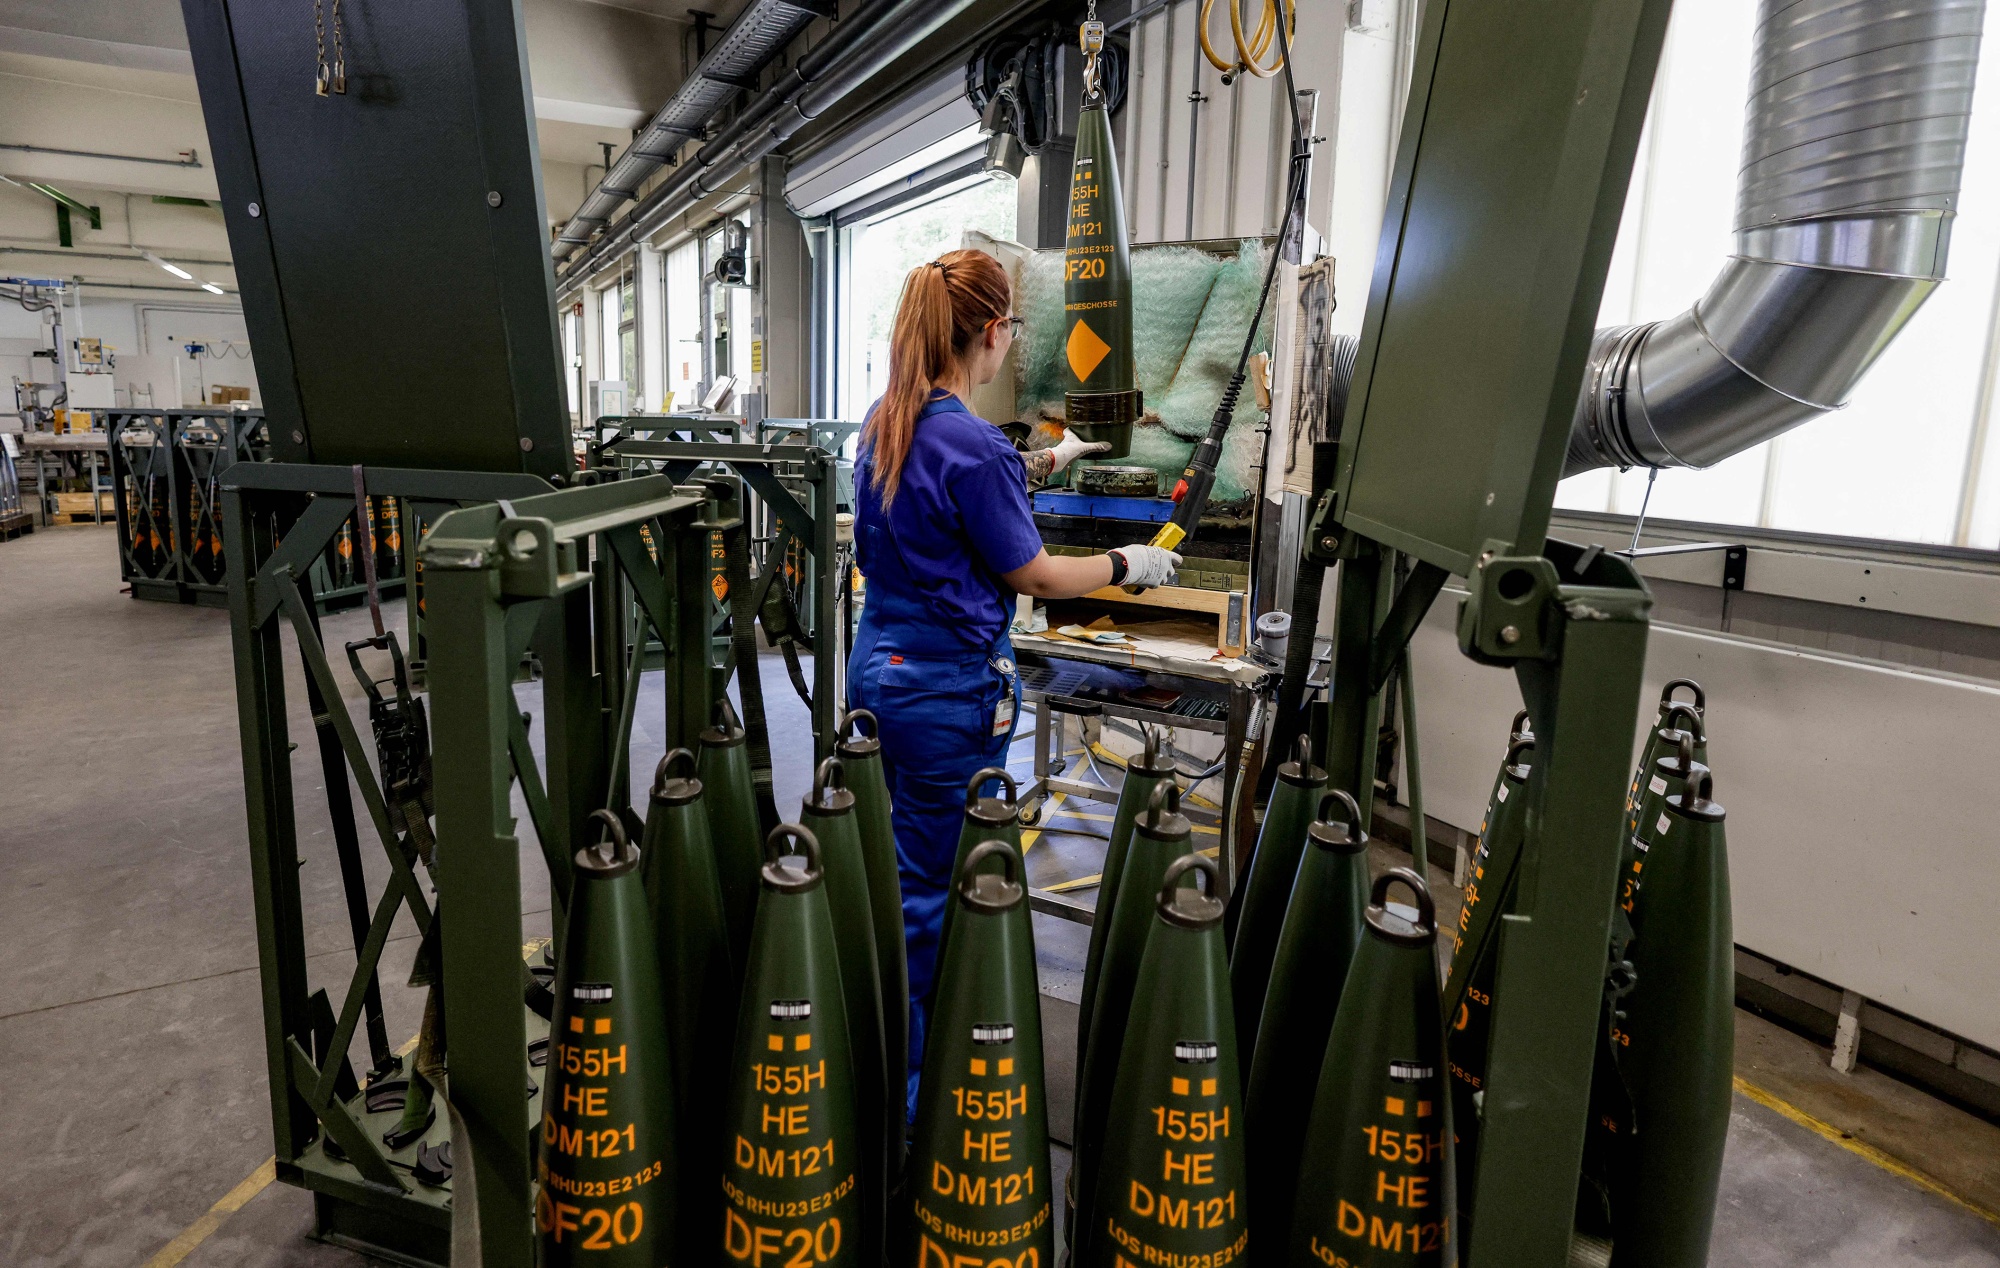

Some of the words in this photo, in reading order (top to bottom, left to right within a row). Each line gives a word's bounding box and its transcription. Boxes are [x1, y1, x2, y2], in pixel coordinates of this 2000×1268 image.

[1072, 203, 1090, 218] HE
[557, 1044, 627, 1077] 155H
[751, 1059, 826, 1096] 155H
[563, 1083, 608, 1117] HE
[762, 1103, 810, 1136] HE
[952, 1083, 1028, 1121] 155H
[544, 1112, 636, 1158] DM121
[1152, 1105, 1230, 1143] 155H
[735, 1134, 835, 1179] DM121
[962, 1129, 1012, 1164] HE
[1362, 1124, 1447, 1165] 155H
[550, 1160, 662, 1197] RHU23E2123
[932, 1160, 1035, 1206] DM121
[1163, 1148, 1215, 1186] HE
[722, 1173, 745, 1206] LOS
[747, 1173, 855, 1218] RHU23E2123
[1129, 1179, 1236, 1230] DM121
[1375, 1169, 1431, 1209] HE
[535, 1187, 644, 1251] DF20
[725, 1205, 842, 1268] DF20
[914, 1198, 942, 1234] LOS
[945, 1201, 1050, 1247] RHU23E2123
[1108, 1217, 1141, 1256] LOS
[1336, 1199, 1451, 1255] DM121
[918, 1232, 1039, 1268] D0
